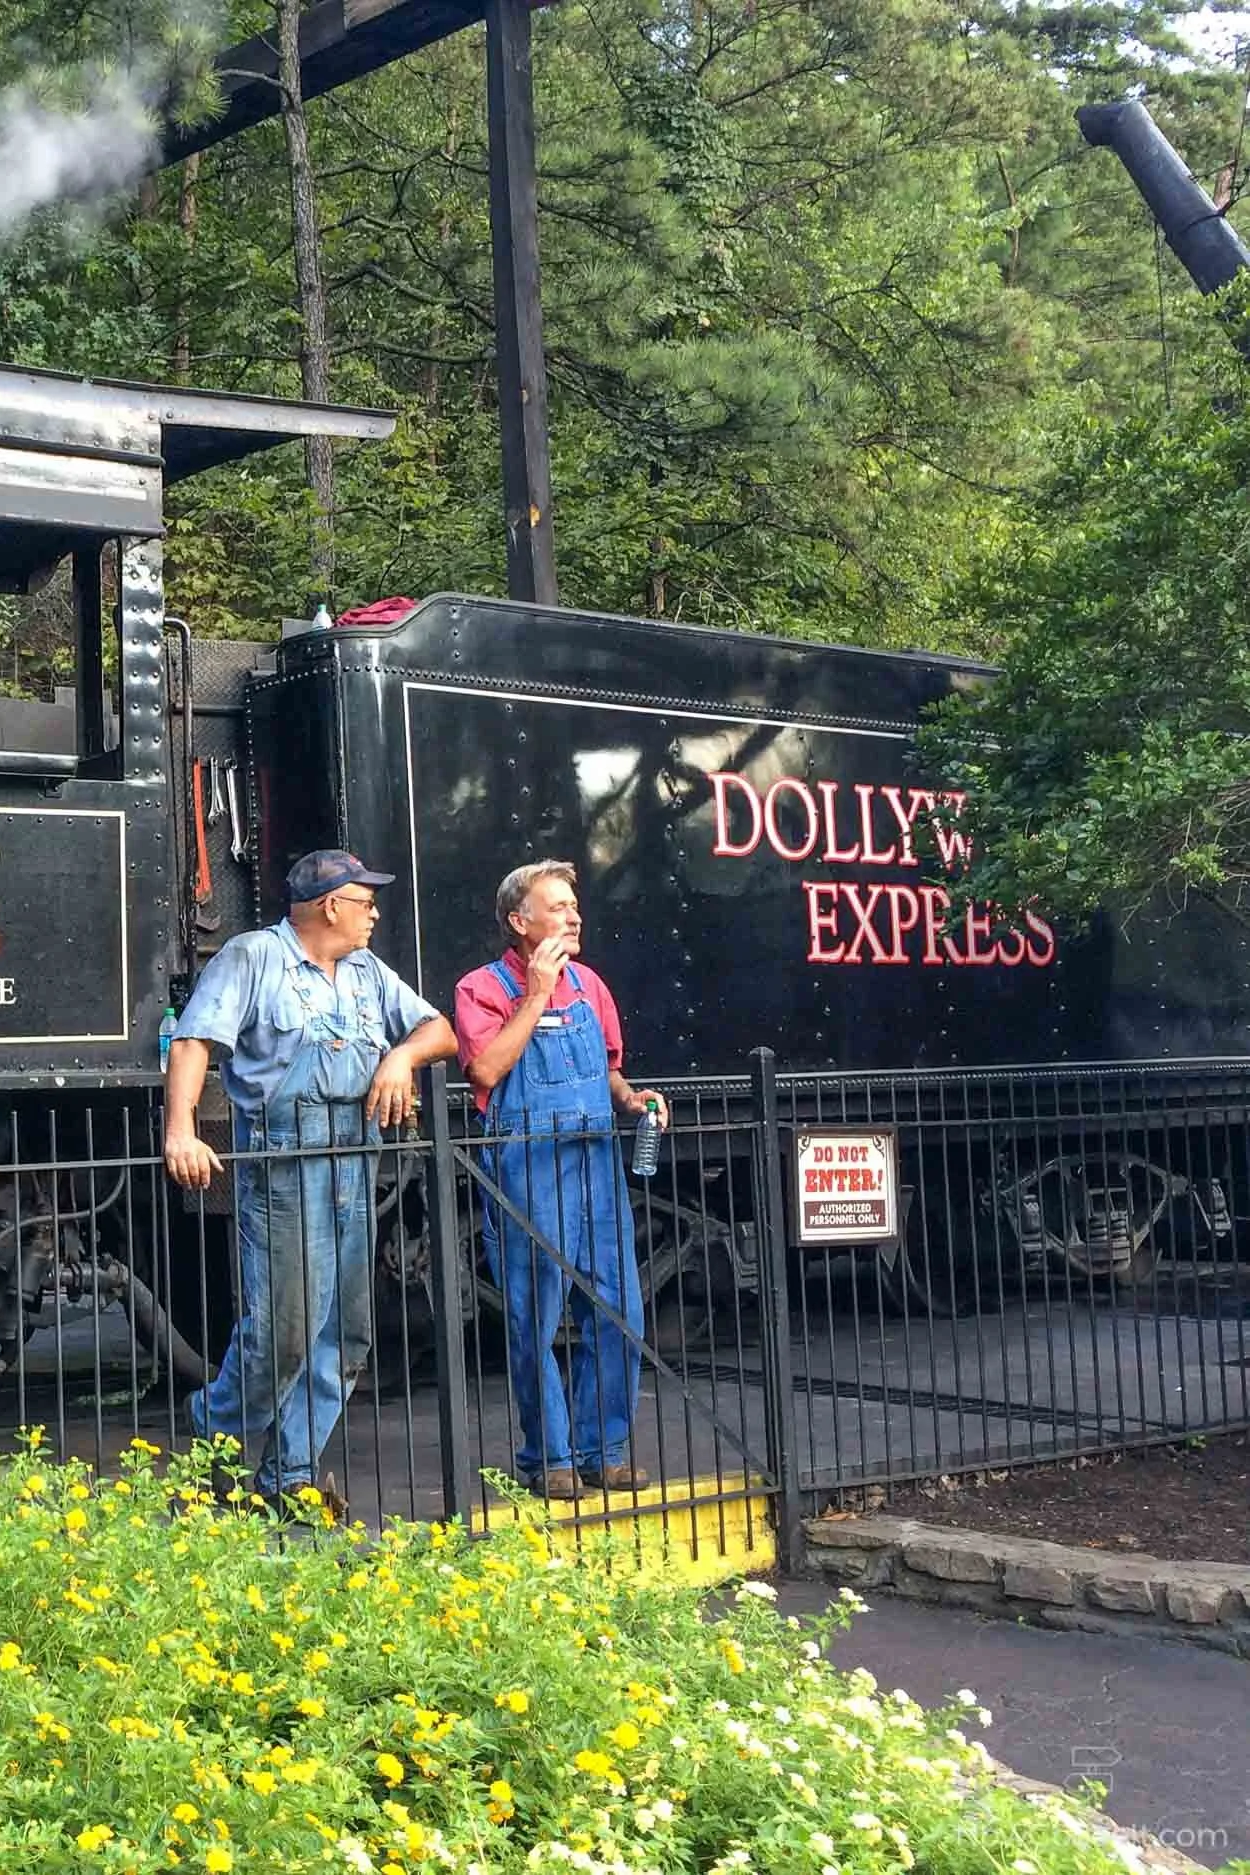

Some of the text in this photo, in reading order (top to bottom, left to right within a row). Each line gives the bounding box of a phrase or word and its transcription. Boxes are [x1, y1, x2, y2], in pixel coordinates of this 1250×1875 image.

[813, 1146, 869, 1163] DO NOT
[804, 1168, 884, 1193] ENTER!
[818, 1203, 872, 1214] AUTHORIZED
[809, 1213, 881, 1225] PERSONNEL ONLY
